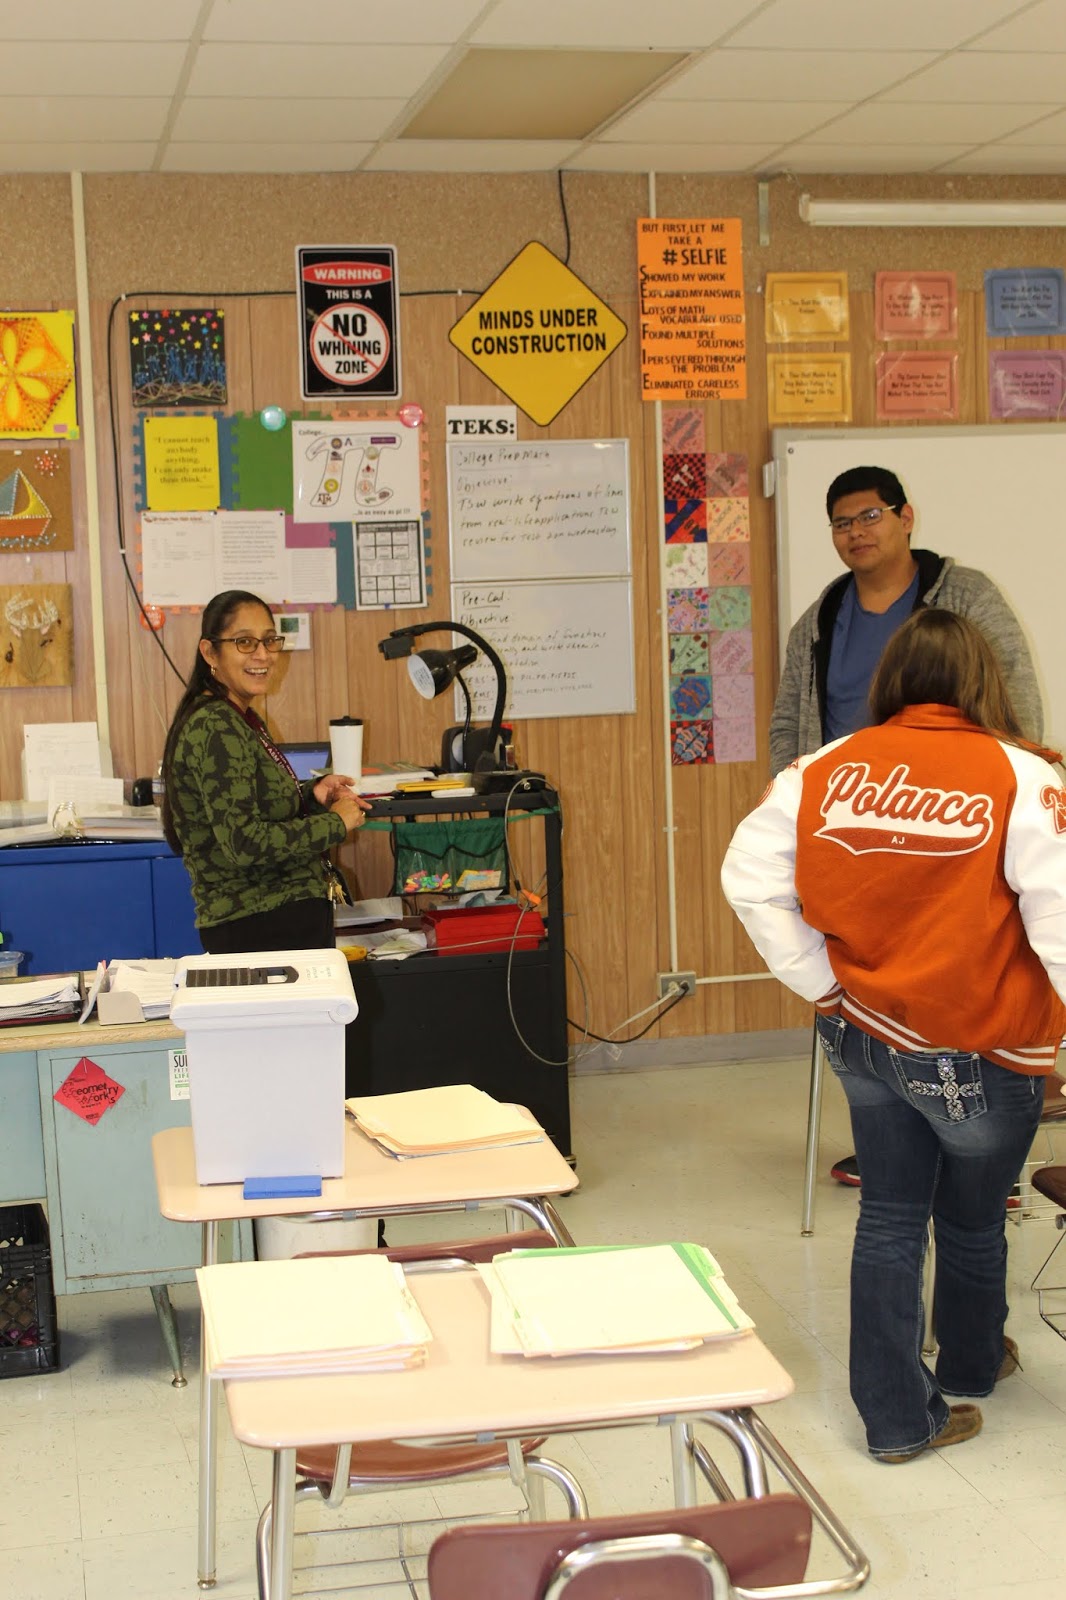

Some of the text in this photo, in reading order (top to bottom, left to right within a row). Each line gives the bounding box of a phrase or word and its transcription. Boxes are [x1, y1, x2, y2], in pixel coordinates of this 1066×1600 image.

[642, 223, 658, 233] BUT
[690, 224, 705, 233] LET
[711, 223, 725, 232] ME
[668, 236, 702, 245] TAKE A
[314, 268, 382, 281] WARNING
[682, 273, 695, 281] MY
[698, 273, 726, 282] WORK
[326, 289, 372, 300] THIS IS A
[690, 289, 702, 298] MY
[703, 290, 741, 299] ANSWER
[666, 305, 676, 314] OF
[679, 305, 705, 314] MATH
[479, 308, 598, 330] MINDS UNDER
[720, 315, 742, 323] USED
[332, 313, 367, 337] NO
[675, 330, 715, 340] MULTIPLE
[318, 340, 381, 356] WHINING
[471, 333, 607, 356] CONSTRUCTION
[697, 340, 744, 348] SOLUTIONS
[705, 355, 746, 363] THROUGH
[335, 359, 369, 375] ZONE
[672, 364, 735, 373] THE PROBLEM
[697, 380, 739, 389] CARELESS
[685, 390, 721, 399] ERRORS
[447, 418, 515, 435] TEKS:
[166, 446, 198, 454] anybody
[174, 466, 190, 474] only
[492, 496, 524, 508] write
[820, 762, 991, 829] Polanco
[891, 836, 906, 845] AJ
